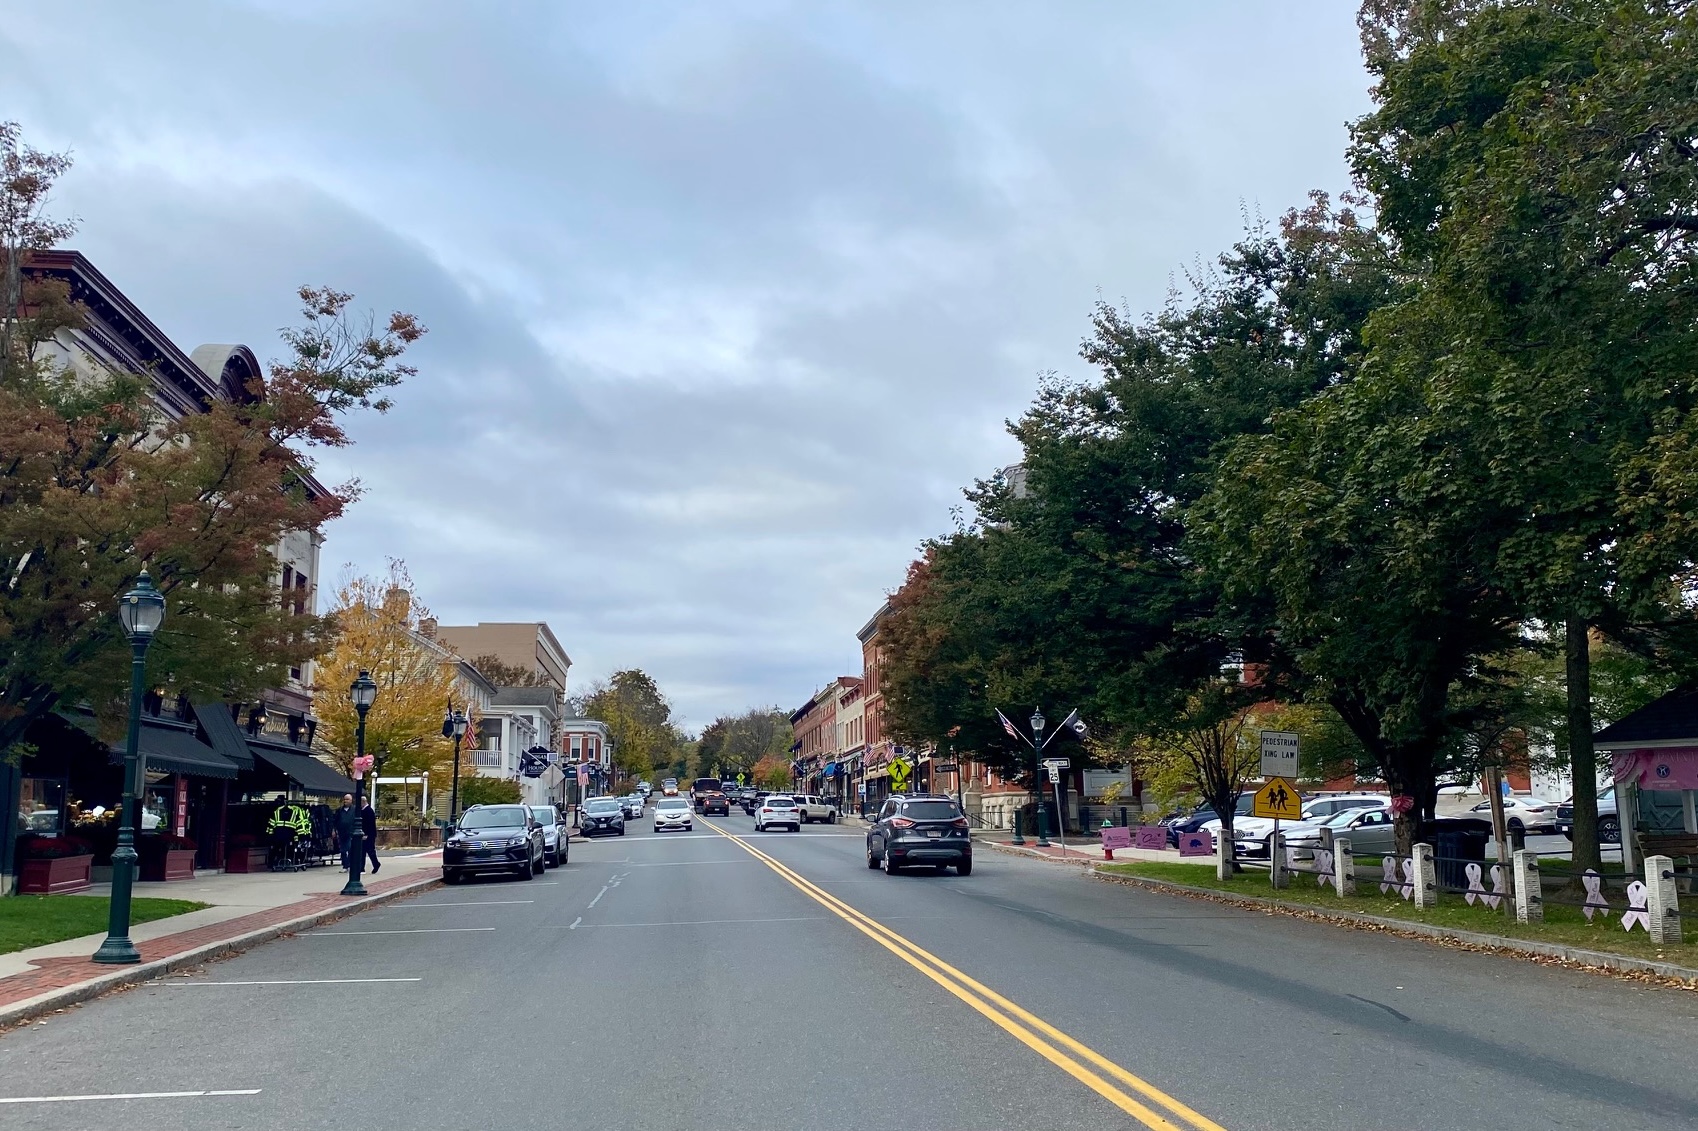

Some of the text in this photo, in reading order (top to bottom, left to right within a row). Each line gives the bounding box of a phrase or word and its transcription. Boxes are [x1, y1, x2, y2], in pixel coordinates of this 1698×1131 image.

[1262, 737, 1298, 747] PEDESTRIAN
[1264, 750, 1295, 759] XING LAW
[1050, 772, 1059, 781] 25
